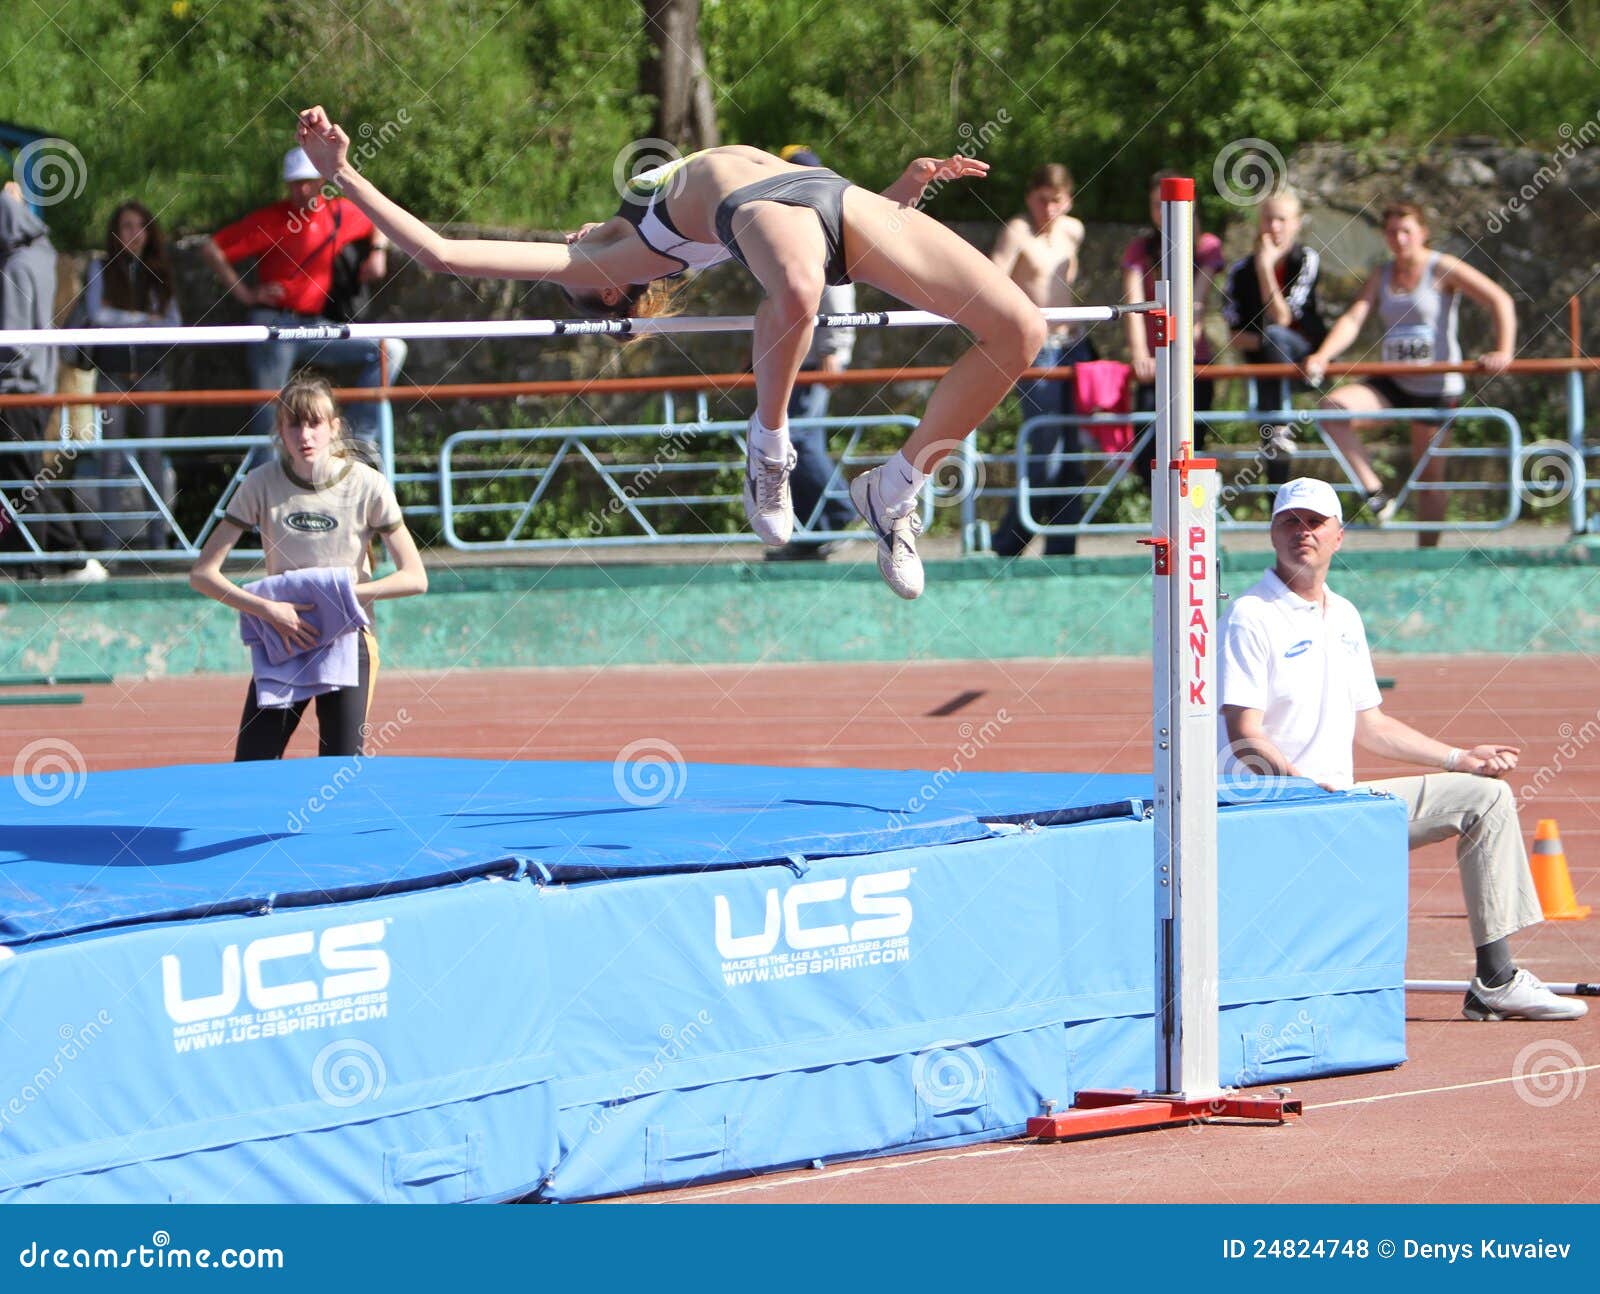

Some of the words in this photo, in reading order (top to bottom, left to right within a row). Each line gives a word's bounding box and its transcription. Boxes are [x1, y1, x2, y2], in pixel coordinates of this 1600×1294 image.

[1189, 526, 1209, 705] POLANIK
[714, 868, 913, 960] UCS
[161, 918, 391, 1024] UCS
[721, 959, 757, 972] MADE
[759, 957, 769, 967] IN
[770, 953, 789, 965] THE
[173, 1022, 209, 1038] MADE
[211, 1018, 225, 1032] IN
[228, 1014, 254, 1028] THE
